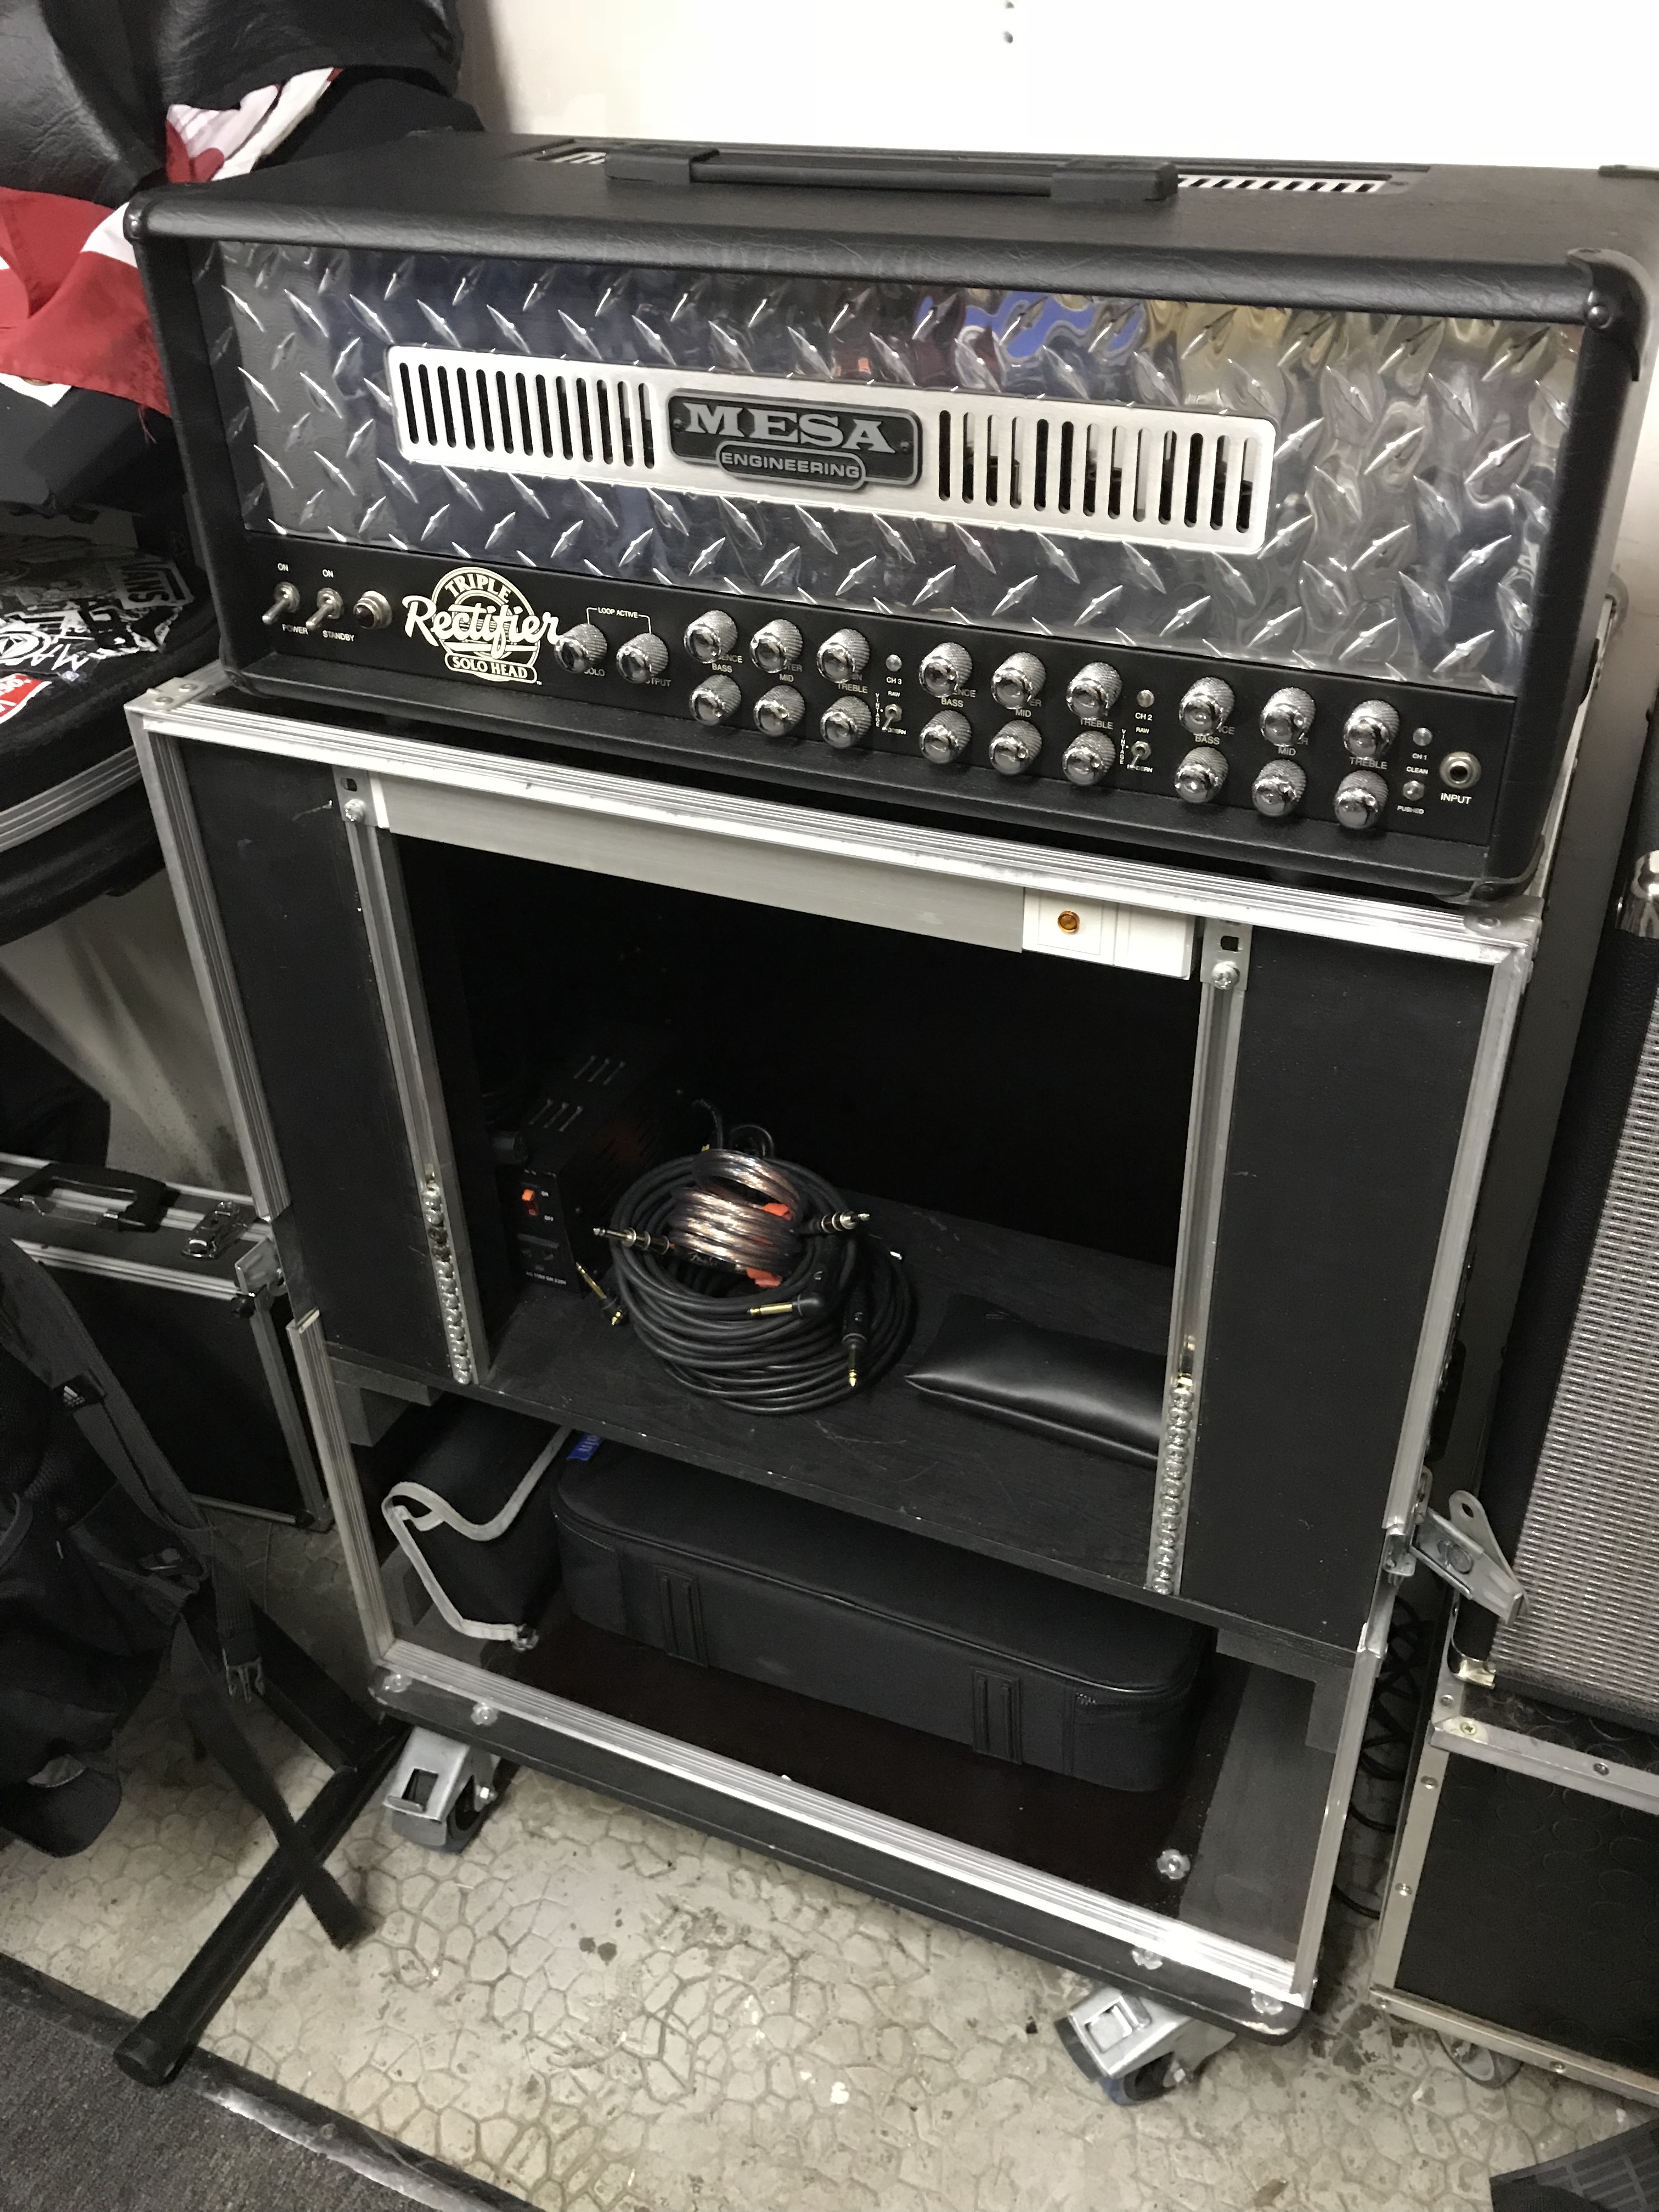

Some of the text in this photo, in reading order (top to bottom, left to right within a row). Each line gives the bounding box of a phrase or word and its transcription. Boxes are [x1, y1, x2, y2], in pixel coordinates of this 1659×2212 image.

[682, 402, 896, 454] MESA
[721, 452, 860, 478] ENGINEERING
[277, 562, 289, 572] ON
[322, 569, 334, 578] ON
[444, 573, 511, 603] TRIPLE
[597, 607, 638, 618] LOOP ACTIVE
[281, 624, 308, 635] POWER
[402, 595, 560, 659] Rectifier
[323, 630, 354, 642] STANDBY
[452, 656, 528, 679] SOLO HEAD
[712, 663, 733, 673] BASS
[779, 673, 794, 682] MID
[837, 682, 868, 694] TREBLE
[941, 698, 964, 708] BASS
[1015, 709, 1031, 718] MID
[1080, 718, 1114, 730] TREBLE
[1194, 735, 1220, 745] BASS
[1278, 747, 1296, 756] MID
[1349, 756, 1388, 770] TREBLE
[1406, 766, 1429, 775] CLEAN
[1440, 792, 1472, 805] INPUT
[1397, 805, 1425, 815] PUSHED
